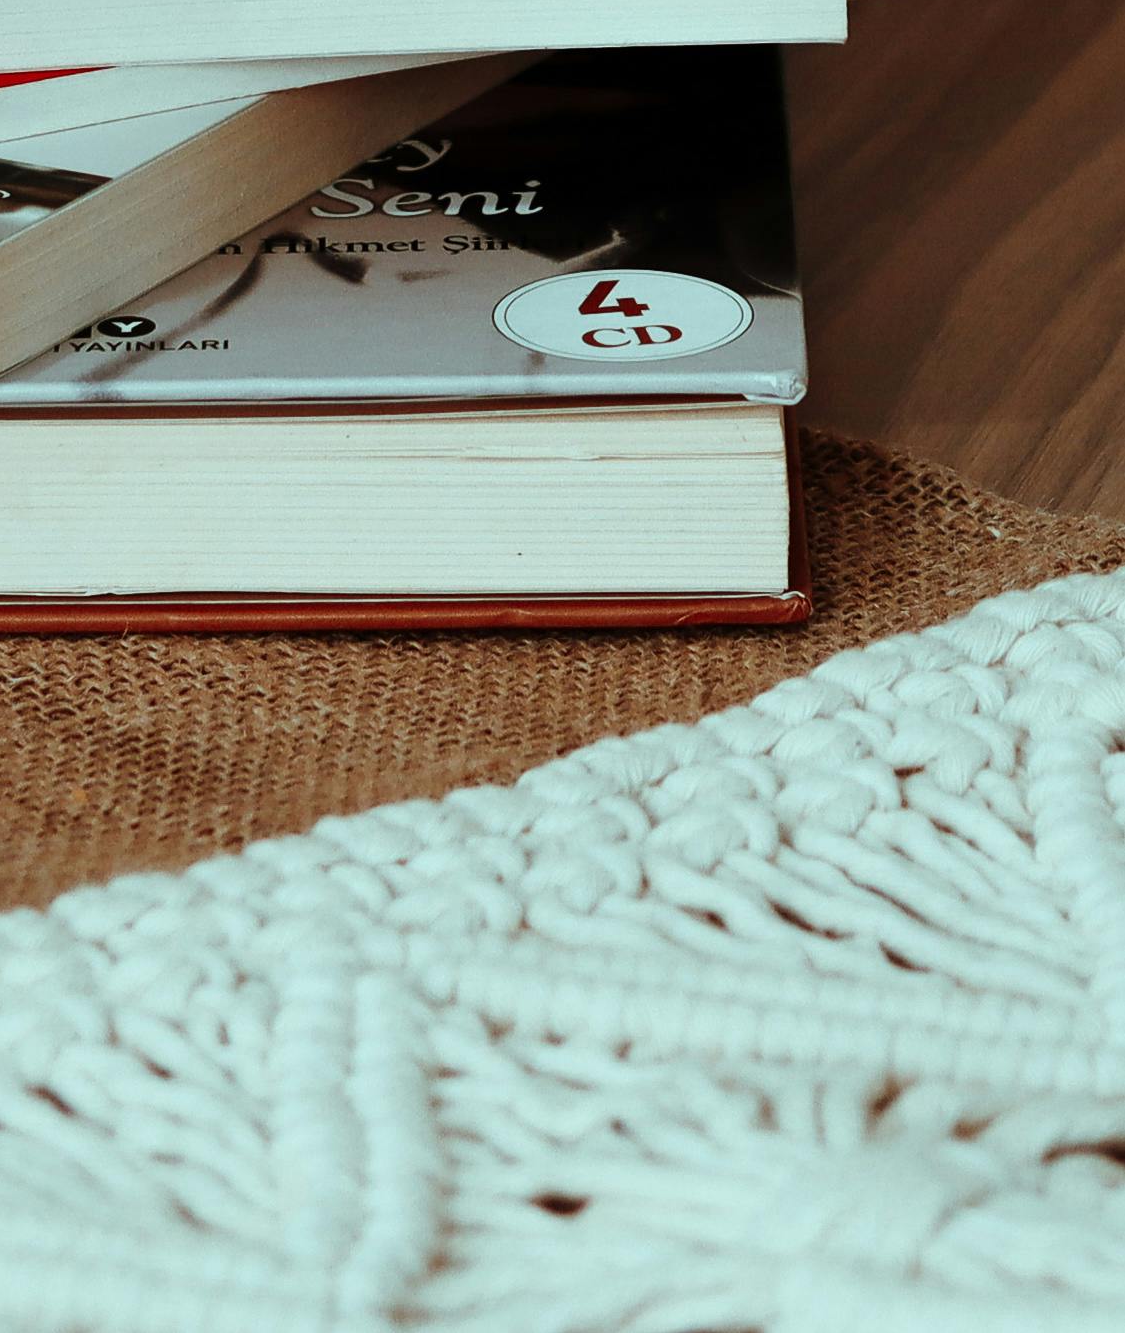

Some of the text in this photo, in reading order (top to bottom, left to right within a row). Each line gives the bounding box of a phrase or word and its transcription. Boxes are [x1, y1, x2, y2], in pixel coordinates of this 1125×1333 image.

[310, 179, 544, 218] Seni
[260, 235, 426, 255] Hikmet
[578, 279, 650, 318] 4
[70, 339, 230, 353] YAYINLARI
[581, 324, 683, 349] CD
